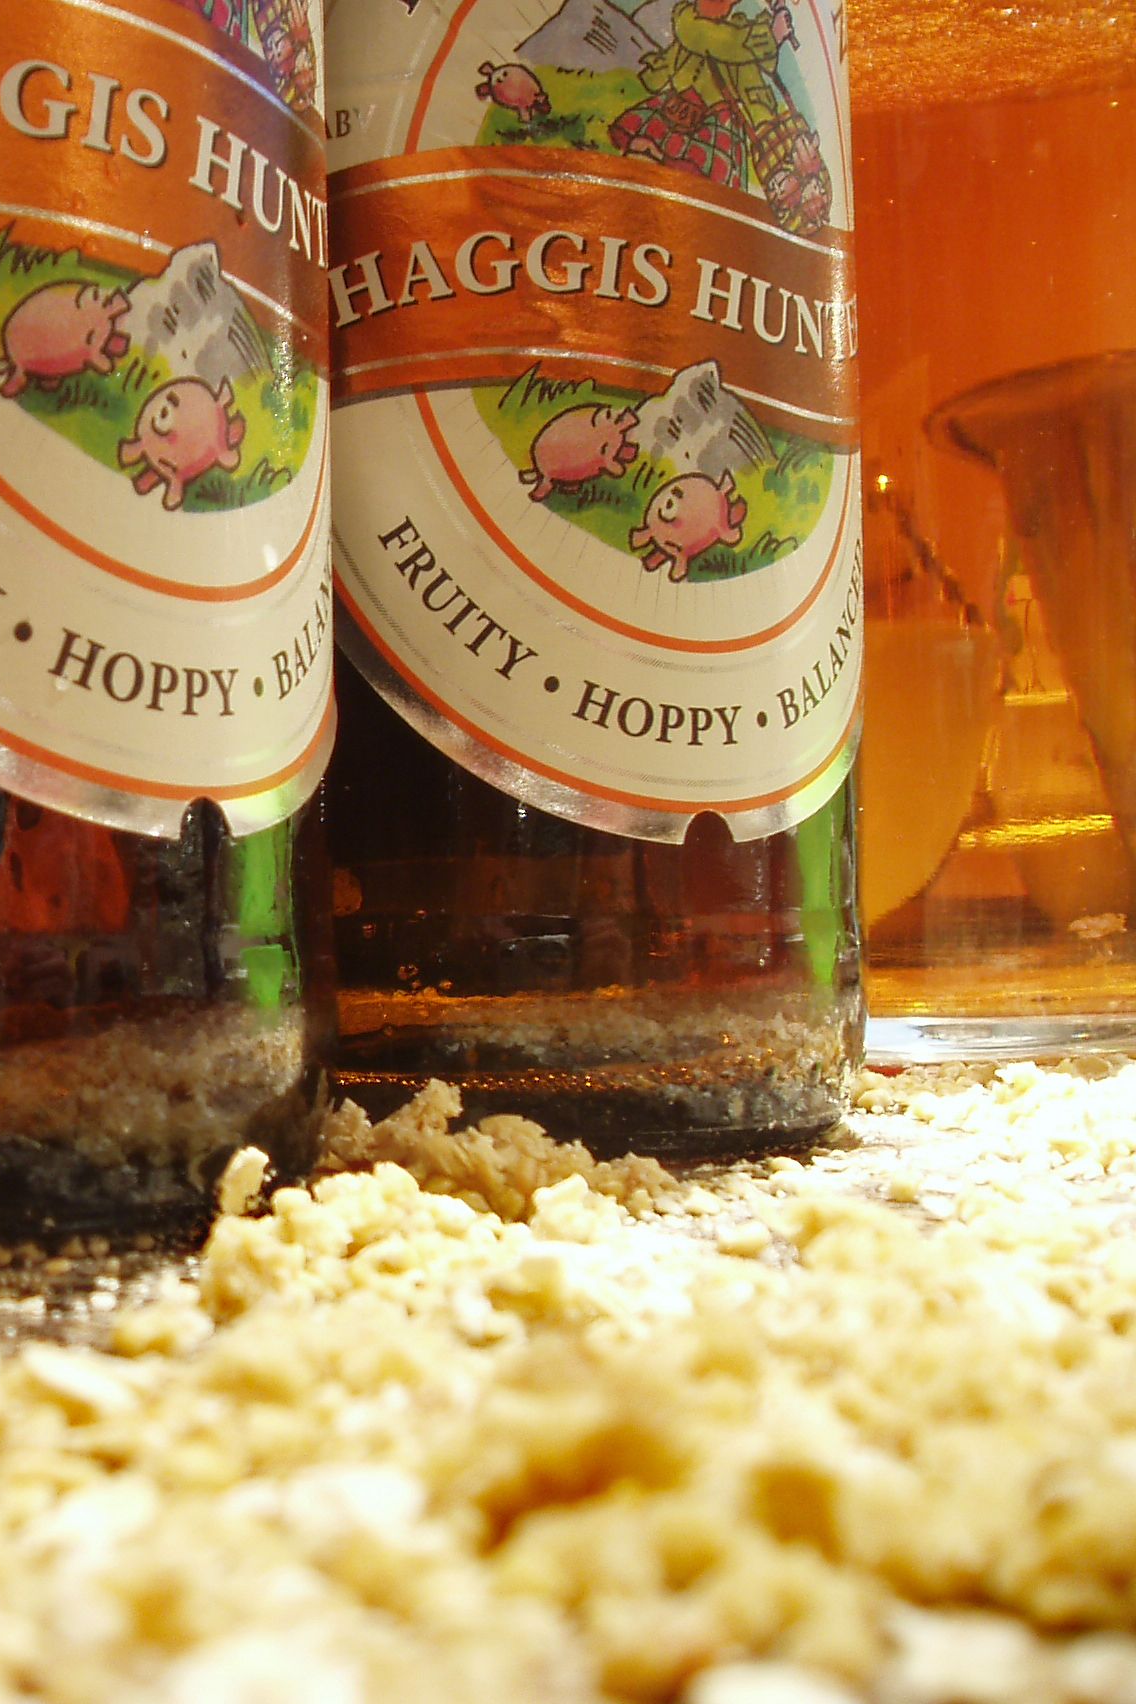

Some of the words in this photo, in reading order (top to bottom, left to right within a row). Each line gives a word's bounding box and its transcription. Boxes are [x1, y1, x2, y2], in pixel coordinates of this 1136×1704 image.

[187, 113, 329, 270] HUNT
[327, 230, 674, 328] HAGGIS
[48, 627, 240, 718] HOPPY
[377, 515, 540, 682] FRUITY
[571, 680, 742, 747] HOPPY
